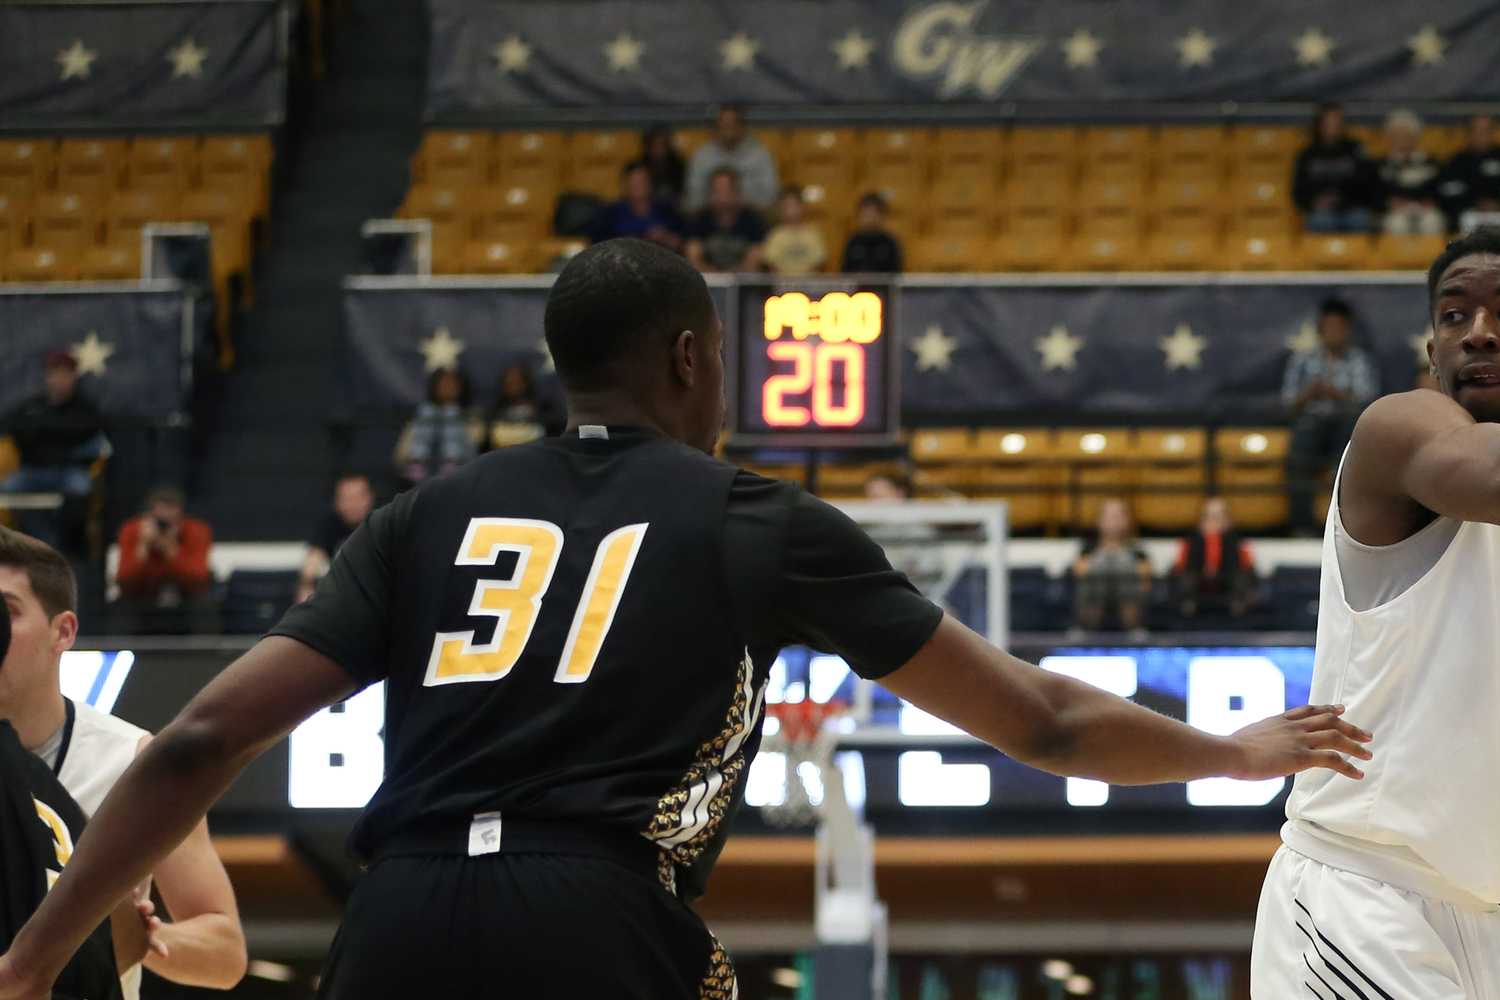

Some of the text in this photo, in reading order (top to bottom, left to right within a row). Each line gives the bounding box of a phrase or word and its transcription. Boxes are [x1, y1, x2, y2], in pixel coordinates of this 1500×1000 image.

[894, 2, 1044, 98] GW
[762, 341, 865, 427] 20
[423, 517, 649, 686] 31
